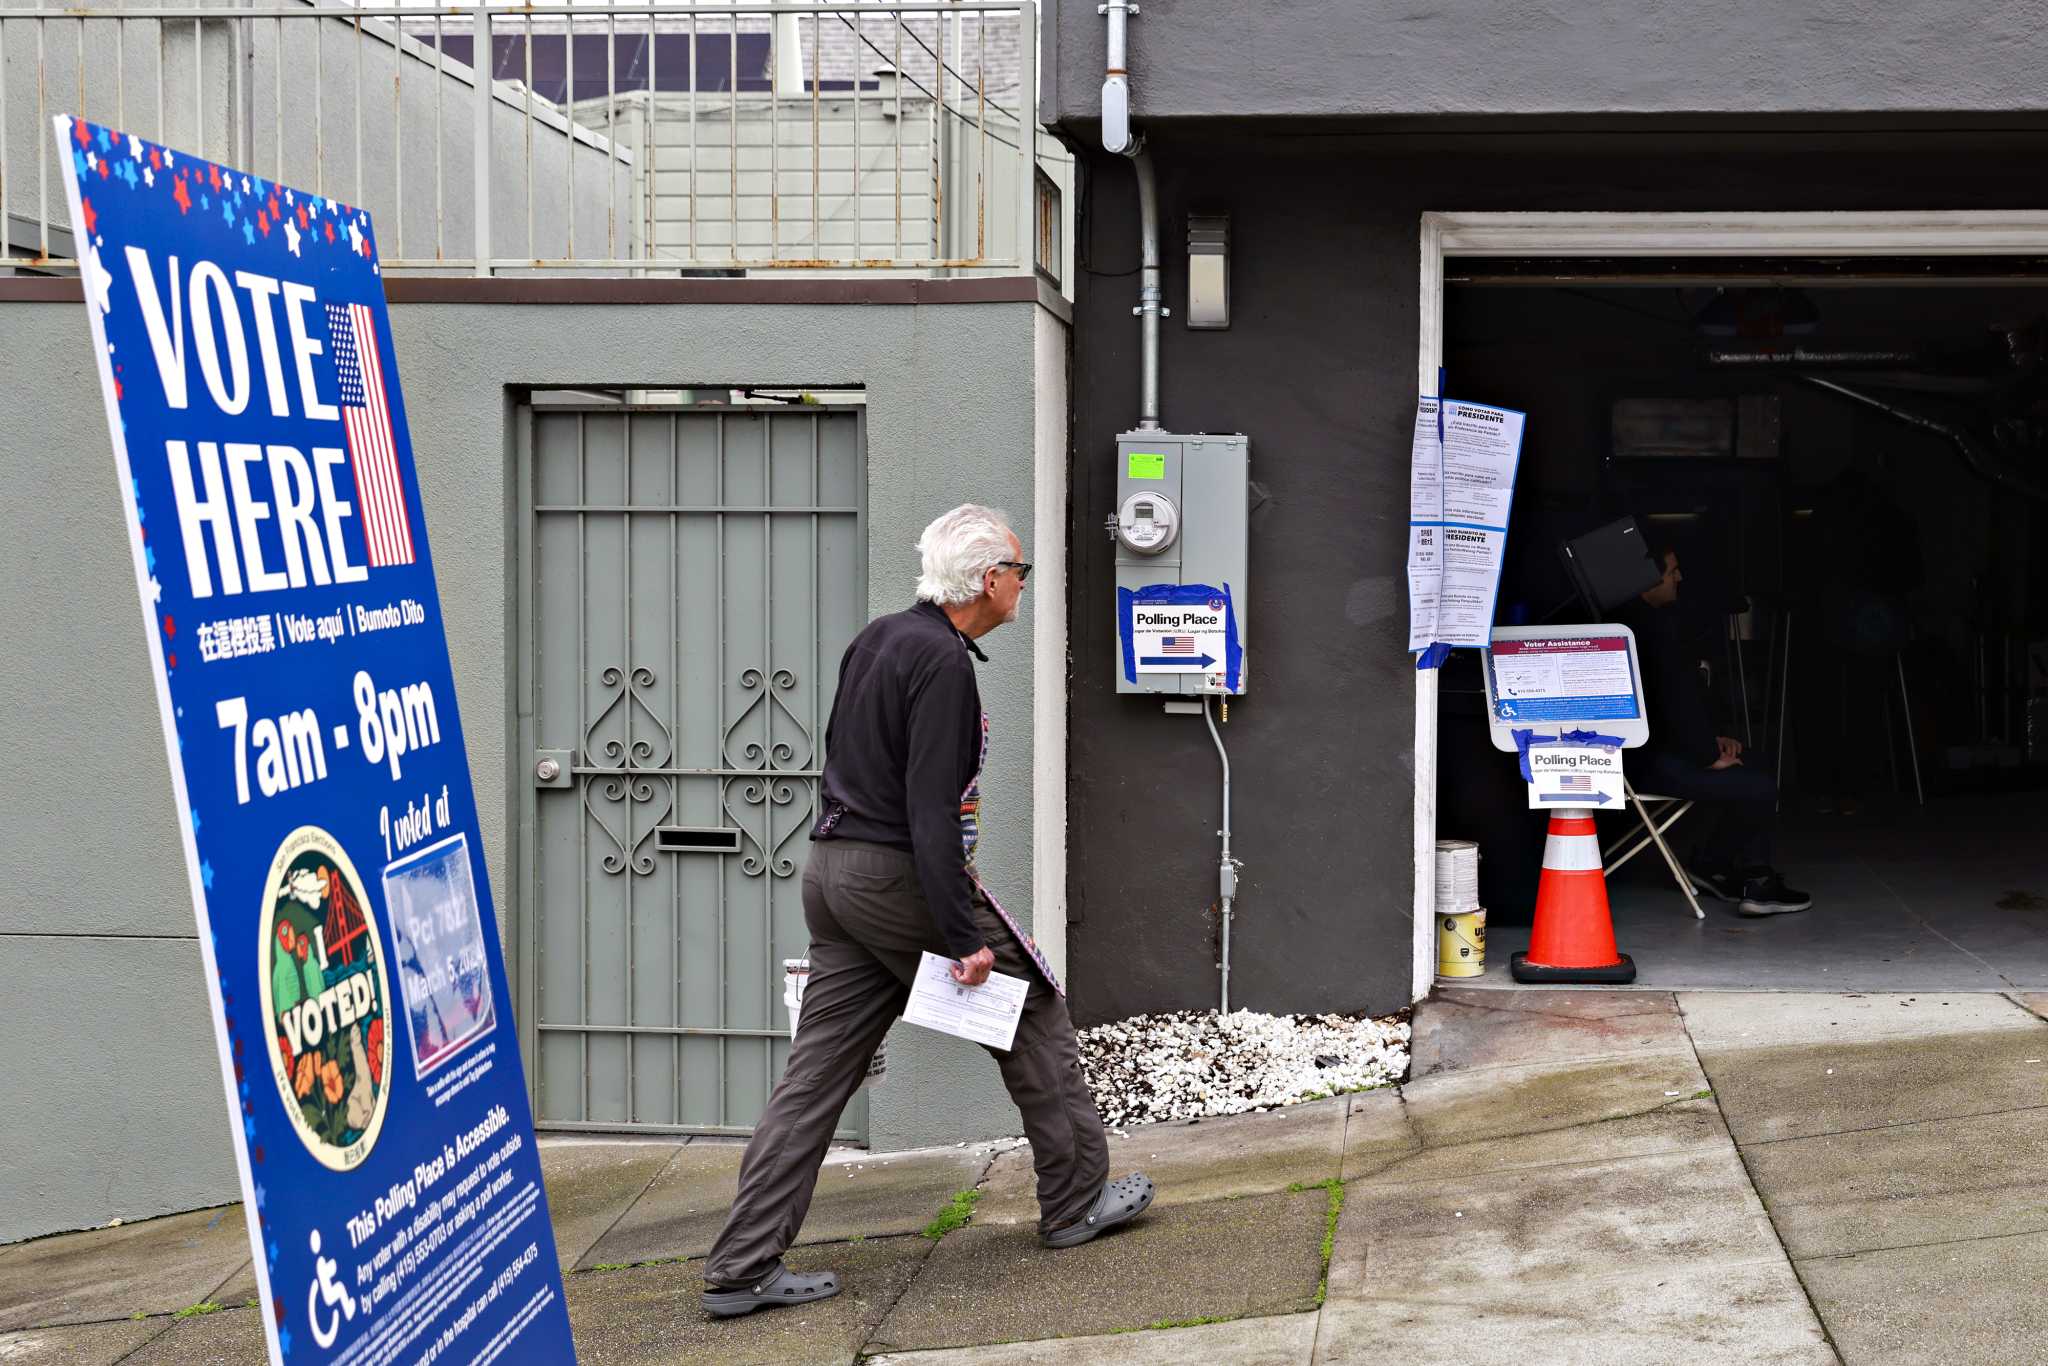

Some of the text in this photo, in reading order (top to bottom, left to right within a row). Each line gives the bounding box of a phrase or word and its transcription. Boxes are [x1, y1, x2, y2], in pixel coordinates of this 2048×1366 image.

[124, 245, 340, 421] VOTE
[1457, 410, 1504, 424] PRESIDENTE
[165, 440, 368, 599] HERE
[1445, 533, 1486, 543] RESIDENTE
[284, 608, 345, 645] Vote aquí
[355, 598, 425, 633] Bumoto Dito
[1136, 613, 1218, 627] Polling Place
[215, 696, 328, 805] 7am
[353, 670, 441, 781] 8pm
[1534, 754, 1612, 767] Polling Place
[393, 792, 432, 851] voted
[436, 784, 451, 828] at
[282, 968, 378, 1057] VOTED!
[346, 1104, 510, 1249] This Polling Place is Accessible.
[357, 1260, 373, 1287] Any
[372, 1243, 392, 1272] voter
[391, 1228, 408, 1255] with
[412, 1201, 442, 1237] disability
[441, 1186, 457, 1211] may
[455, 1166, 481, 1199] request
[486, 1151, 501, 1172] vote
[500, 1132, 522, 1162] outside
[361, 1292, 373, 1315] by
[372, 1272, 397, 1303] calling
[396, 1250, 416, 1286] (415)
[446, 1218, 455, 1237] or
[453, 1201, 477, 1230] asking
[480, 1181, 493, 1210] poll
